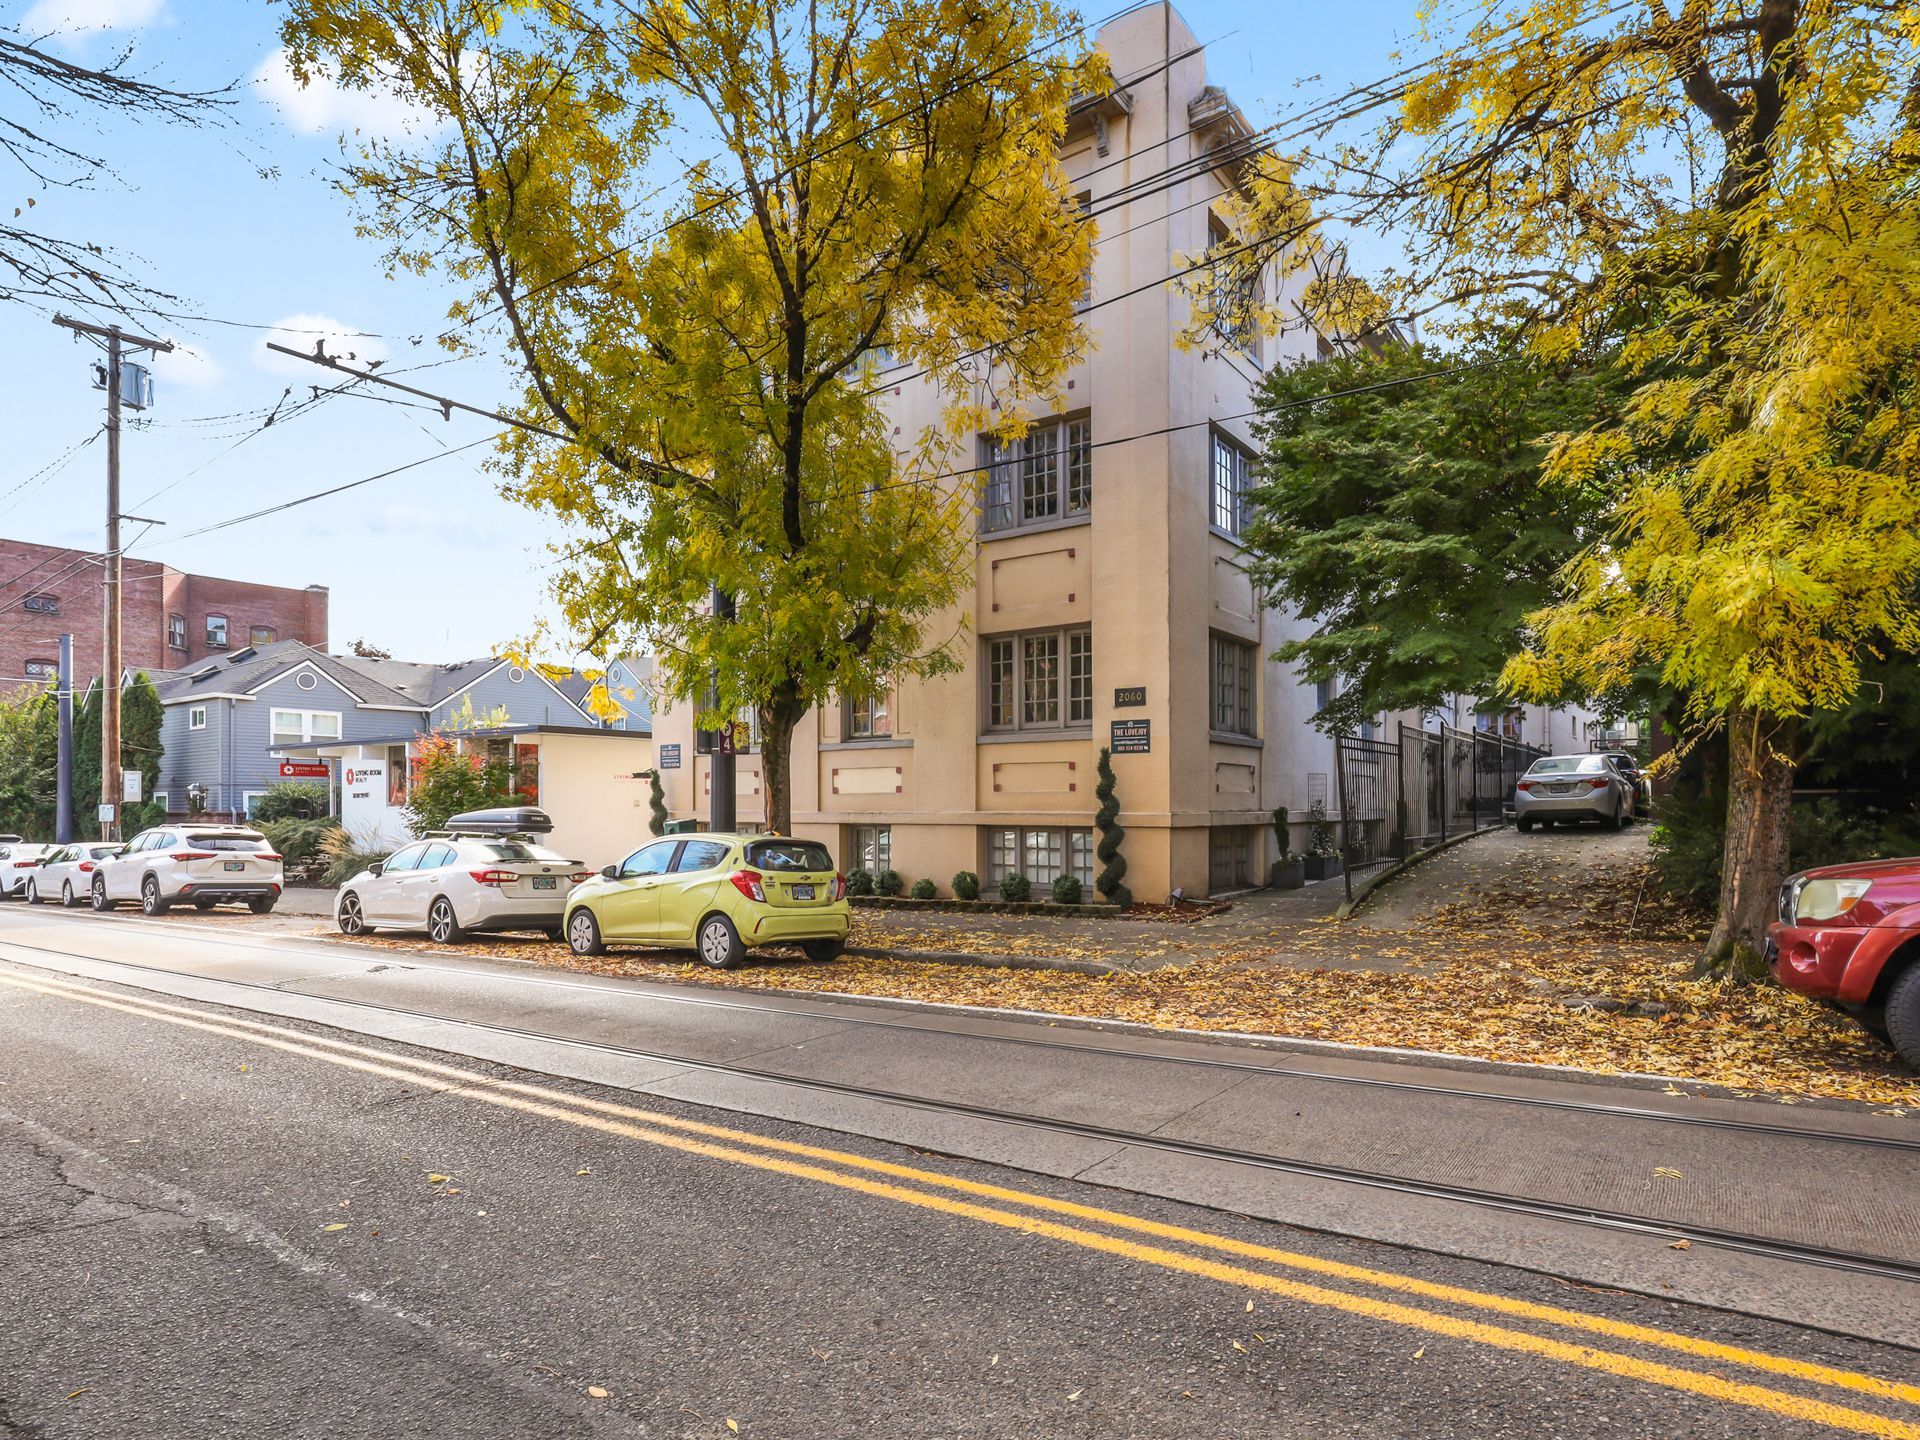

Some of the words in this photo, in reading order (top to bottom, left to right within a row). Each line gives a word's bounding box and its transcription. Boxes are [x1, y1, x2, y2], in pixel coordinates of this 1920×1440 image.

[1119, 692, 1142, 702] 2060
[1125, 728, 1147, 736] LOVEJOY
[724, 738, 731, 750] 4
